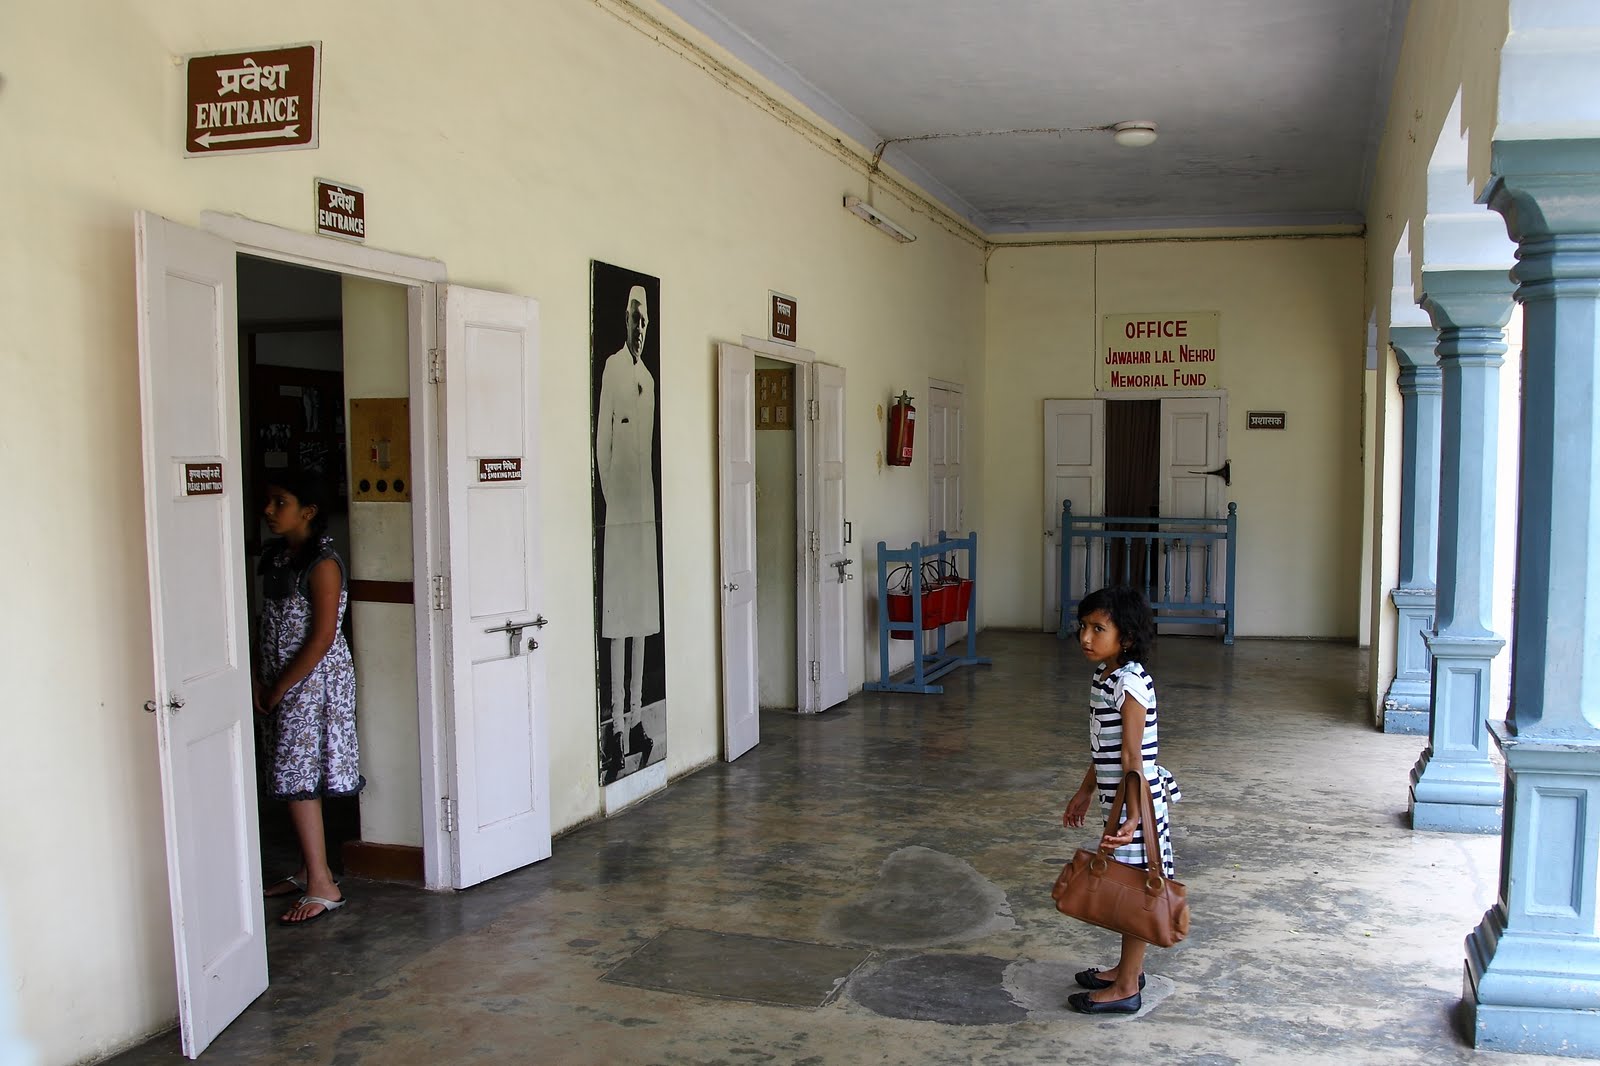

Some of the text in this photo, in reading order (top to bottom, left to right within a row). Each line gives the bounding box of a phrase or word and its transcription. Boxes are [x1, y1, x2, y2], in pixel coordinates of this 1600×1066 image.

[216, 57, 290, 97] प्रवेश
[195, 95, 300, 129] ENTRANCE
[327, 187, 356, 215] प्रवेश
[319, 208, 364, 234] ENTRANCE
[776, 321, 790, 337] EXIT
[1125, 320, 1188, 339] OFFICE
[1105, 344, 1216, 365] JAWAHAR LAL NEHRU
[1111, 368, 1207, 388] MEMORIAL FUND
[1250, 416, 1282, 425] प्रशासक
[488, 471, 507, 480] SMOKING
[187, 482, 201, 492] PLEASE
